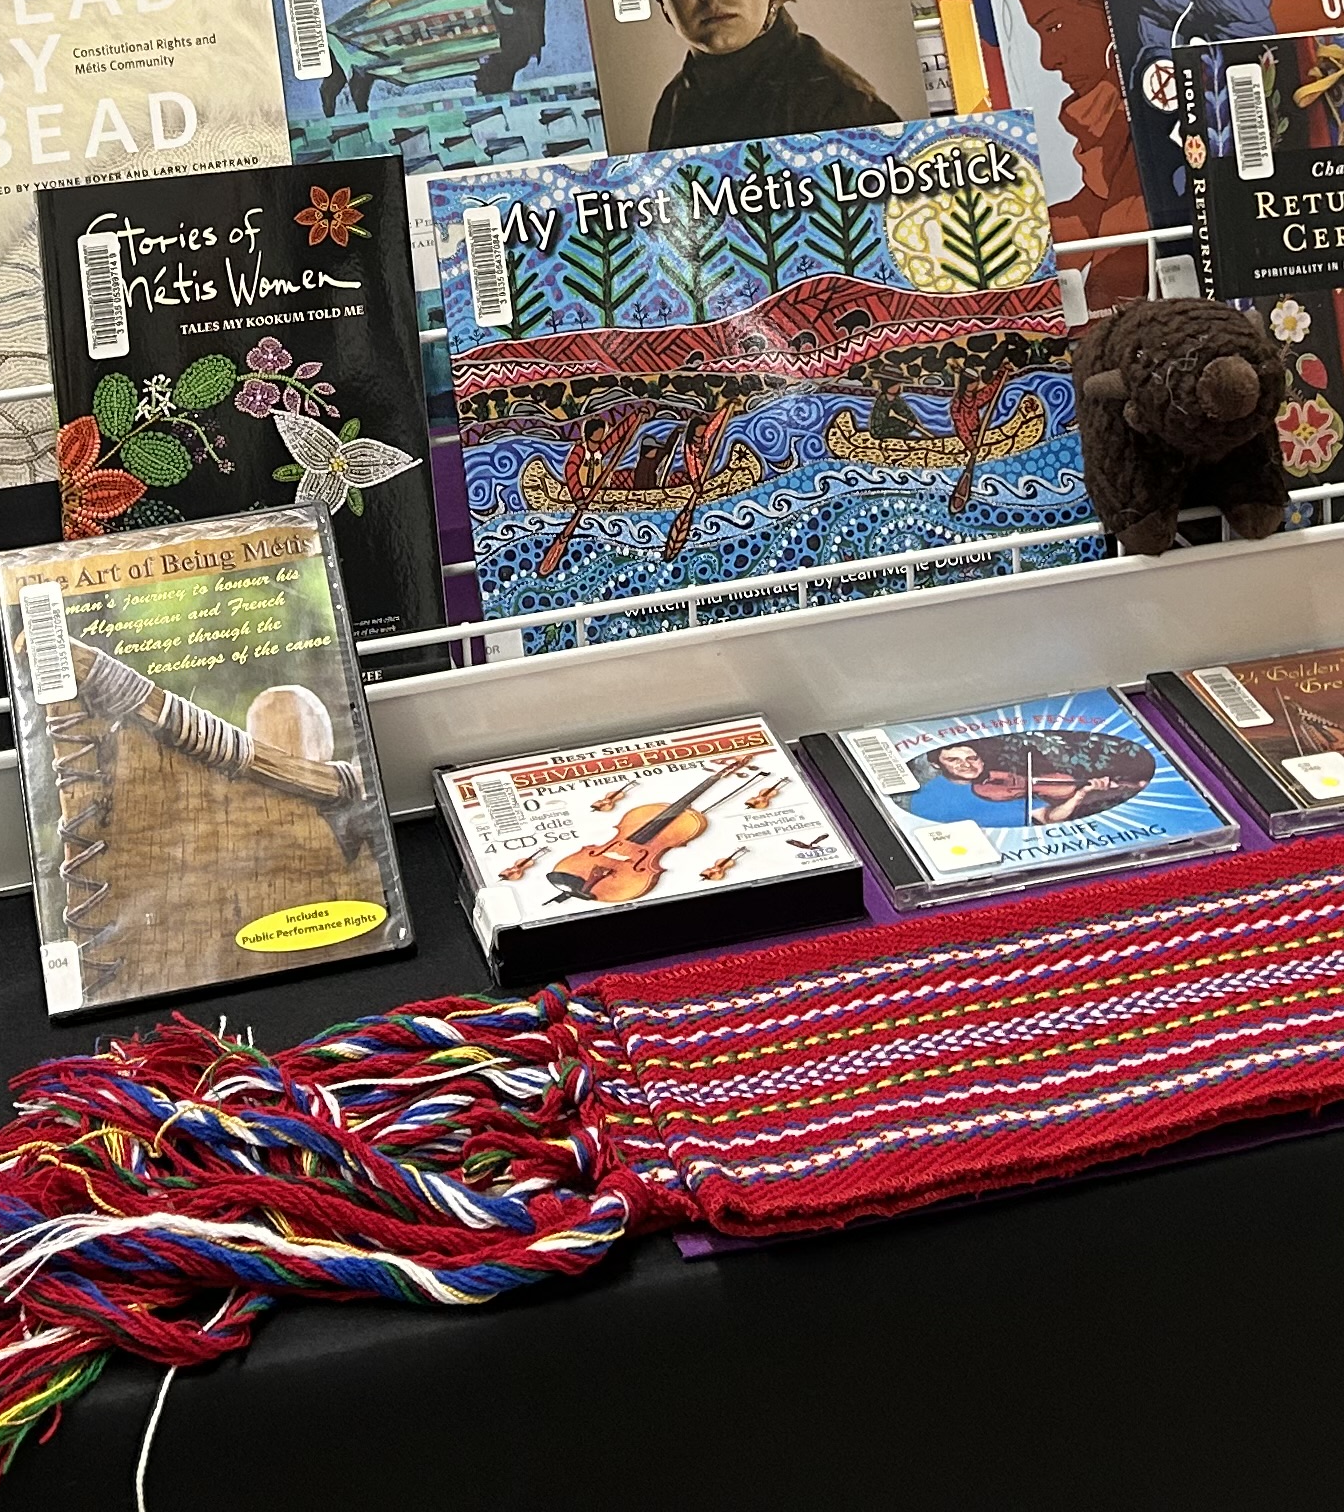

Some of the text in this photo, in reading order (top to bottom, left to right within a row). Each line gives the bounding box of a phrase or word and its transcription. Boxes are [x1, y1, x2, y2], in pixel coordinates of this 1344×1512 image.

[73, 34, 217, 59] Constitutional Rights and
[75, 54, 175, 75] Métis Community
[501, 142, 1018, 250] My First Métis Lobstick
[229, 208, 263, 254] of
[226, 250, 362, 308] Women
[180, 305, 365, 336] TALES MY KOOKUM TOLD ME
[75, 563, 122, 589] Art
[129, 555, 154, 580] of
[161, 549, 236, 577] Being
[243, 536, 313, 565] Métis
[147, 634, 332, 676] teachings of the canoe
[1261, 662, 1339, 683] Golden
[640, 731, 769, 768] FIDDLES
[1045, 822, 1099, 839] CLIFF
[242, 912, 378, 946] Public Performance Rights
[286, 907, 329, 923] Includes
[48, 957, 68, 969] 004
